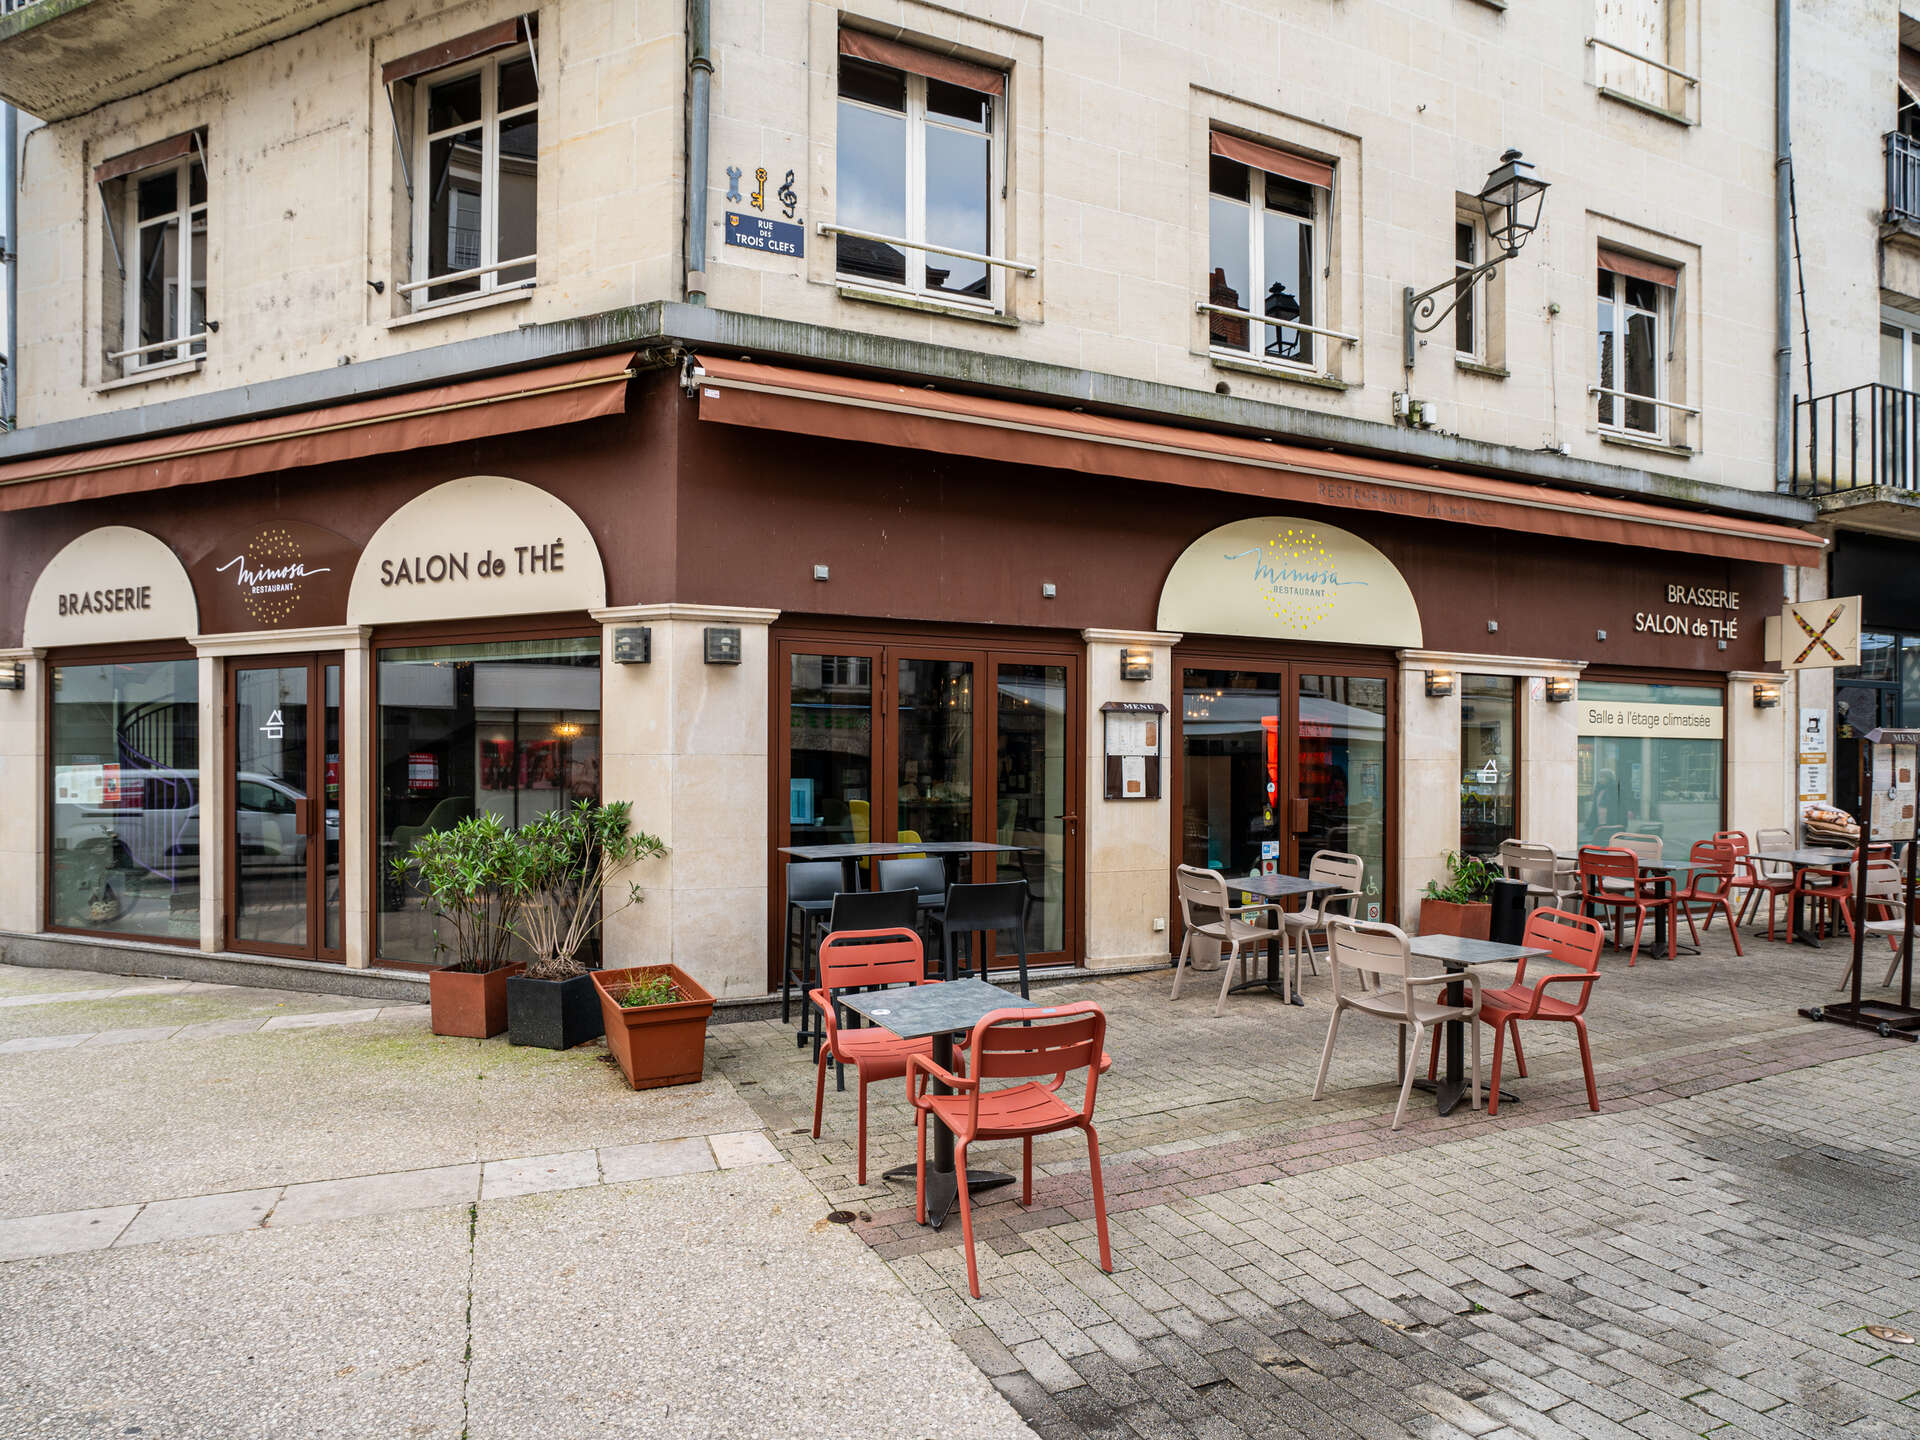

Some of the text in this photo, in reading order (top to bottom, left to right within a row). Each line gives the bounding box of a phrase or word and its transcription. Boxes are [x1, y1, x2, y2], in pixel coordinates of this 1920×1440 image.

[757, 219, 774, 230] RUE
[759, 230, 772, 238] DES
[735, 233, 795, 253] TROIS CLEFS
[1317, 482, 1405, 505] RESTAURANT
[380, 537, 564, 587] SALON de THÉ
[251, 583, 294, 594] RESTAURANT
[1272, 585, 1326, 598] RESTAURANT
[1667, 584, 1740, 610] BRASSERIE
[58, 585, 152, 617] BRASSERIE
[1635, 611, 1738, 639] SALON de THÉ
[1122, 703, 1155, 711] MENU
[1588, 709, 1711, 729] Salle à l'étage climatisée
[1892, 733, 1919, 743] MENU
